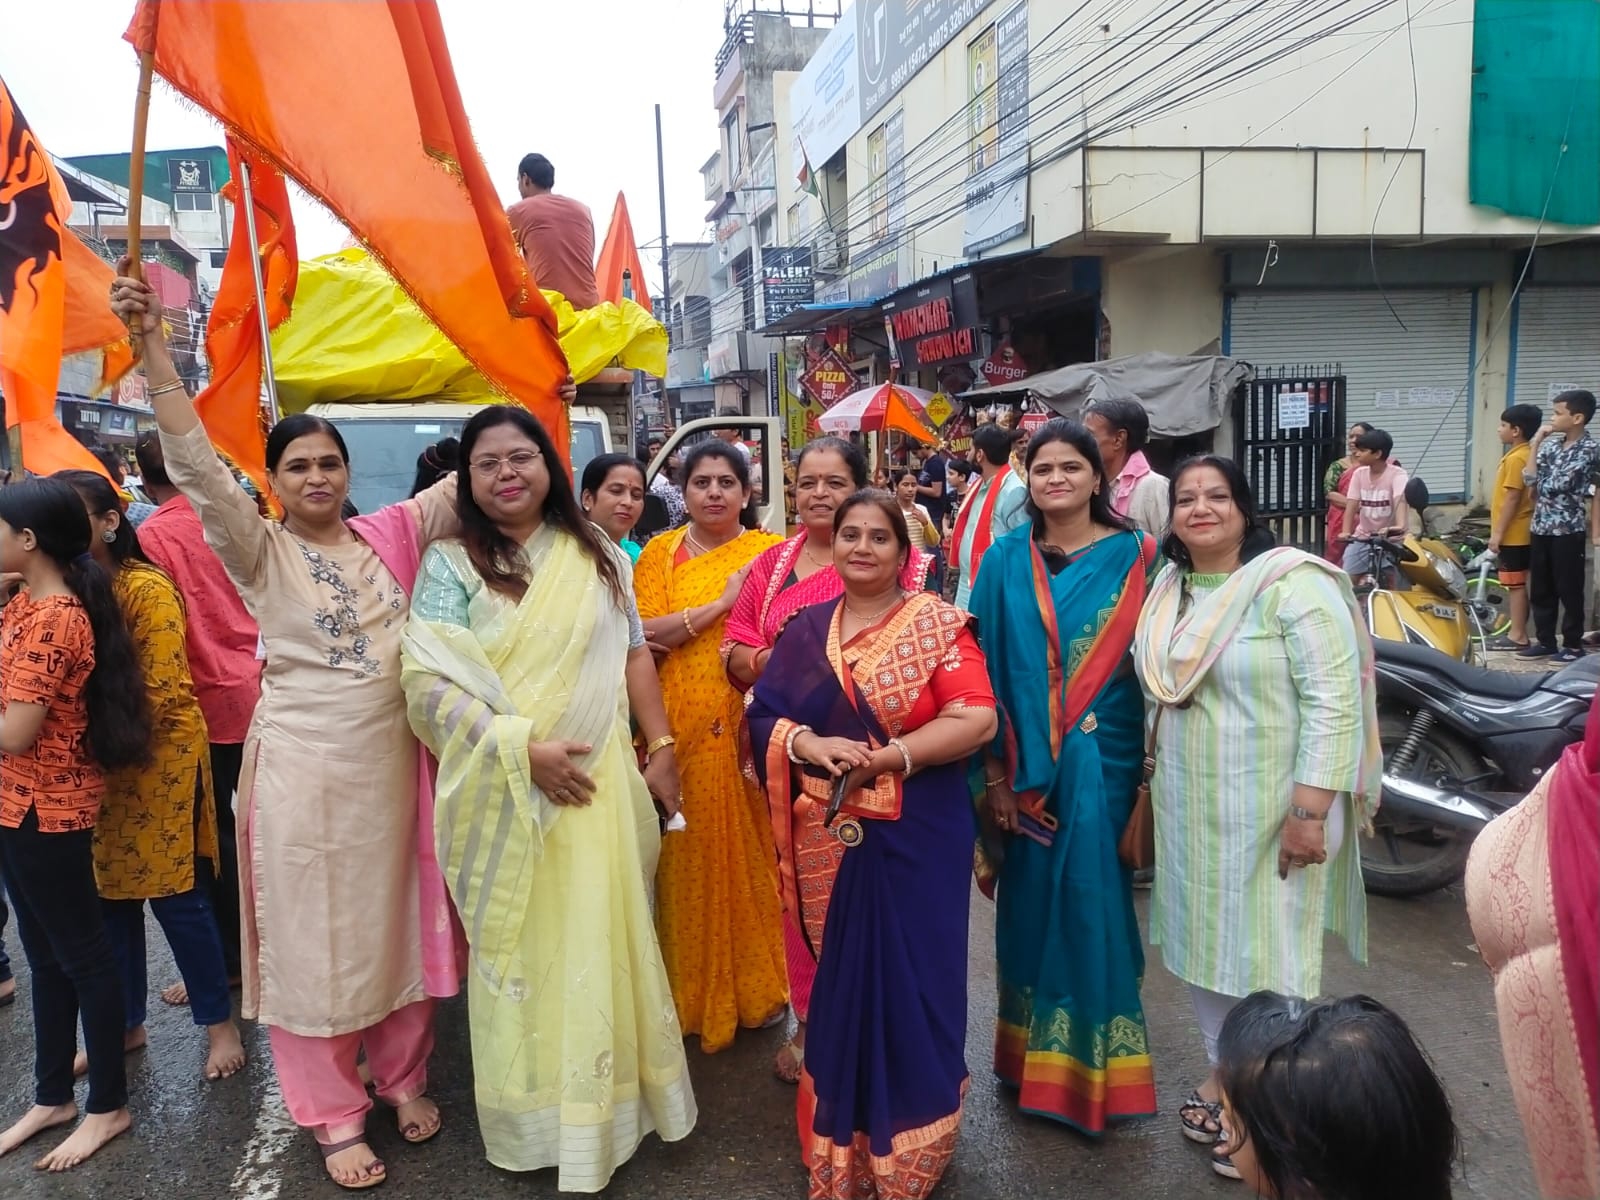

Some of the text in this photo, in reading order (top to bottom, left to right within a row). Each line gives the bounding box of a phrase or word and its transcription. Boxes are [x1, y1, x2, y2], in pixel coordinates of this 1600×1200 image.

[765, 266, 810, 278] TALENT
[916, 327, 972, 364] SANDWICH
[815, 371, 846, 383] PIZZA
[984, 361, 1027, 380] Burger
[821, 390, 839, 400] 50/-
[80, 409, 100, 424] TATTOO
